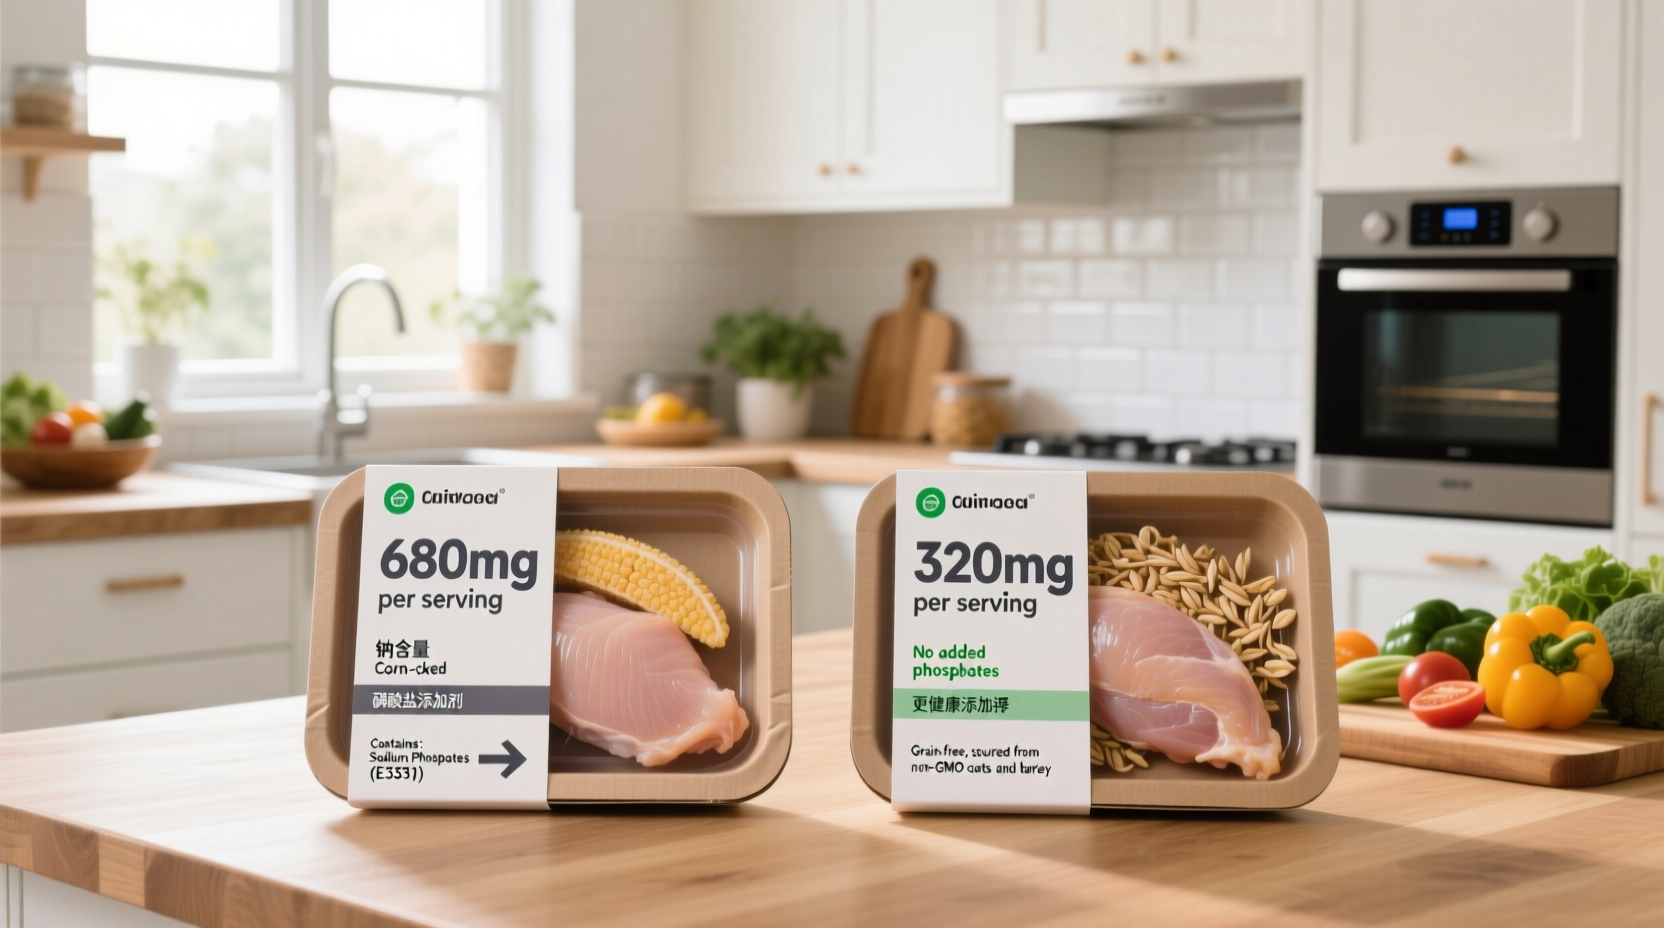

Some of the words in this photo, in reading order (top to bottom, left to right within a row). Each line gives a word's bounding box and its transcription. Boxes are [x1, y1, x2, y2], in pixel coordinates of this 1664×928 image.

[380, 538, 539, 591] 680mg
[914, 541, 1073, 596] 320mg
[378, 593, 416, 614] per
[421, 588, 503, 615] serving
[914, 596, 951, 617] per
[957, 591, 1037, 619] serving
[375, 639, 430, 659] 钠含量
[913, 645, 934, 659] No
[938, 644, 986, 659] added
[1013, 745, 1040, 757] from
[996, 762, 1017, 774] and
